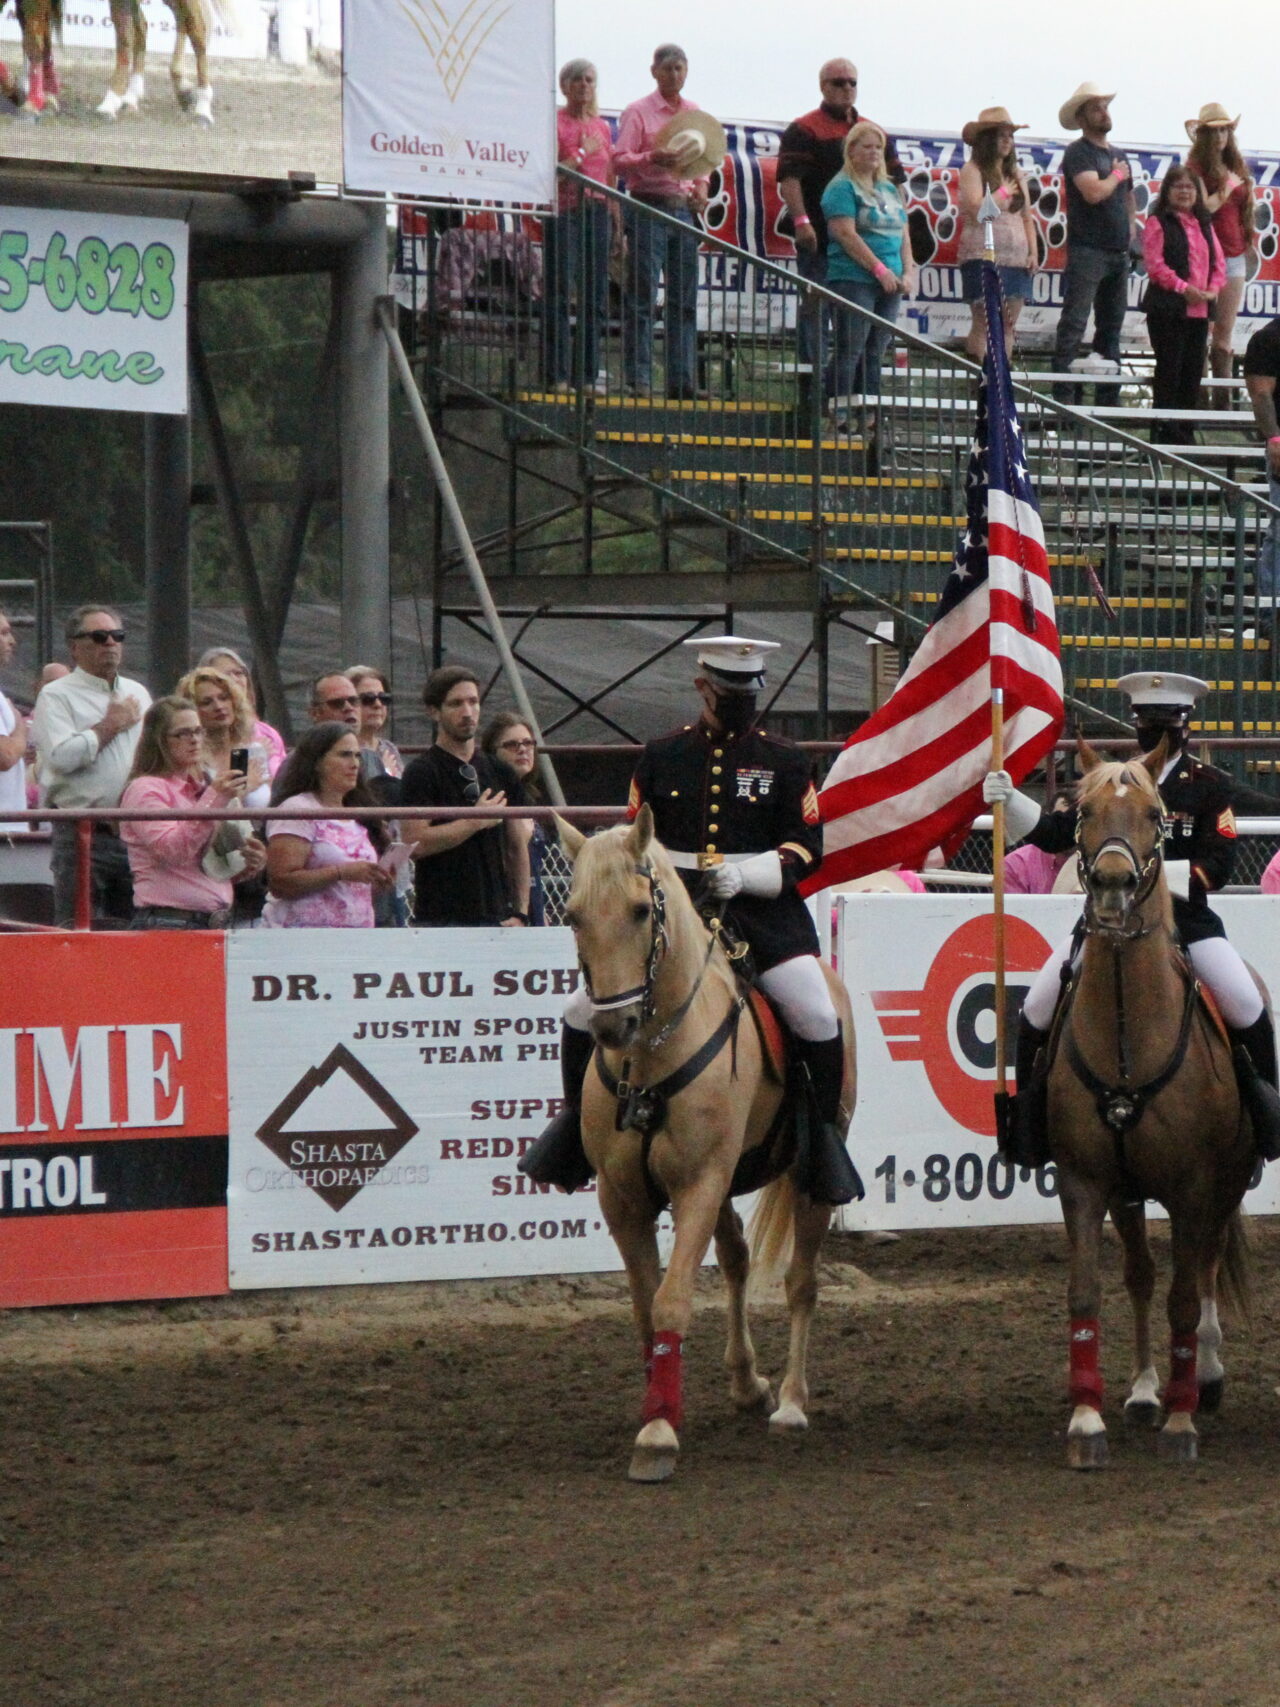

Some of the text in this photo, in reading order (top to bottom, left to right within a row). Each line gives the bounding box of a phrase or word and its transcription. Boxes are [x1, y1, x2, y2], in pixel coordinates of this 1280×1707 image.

[370, 132, 531, 168] Golden Valley
[420, 164, 483, 177] BANK
[252, 974, 331, 1002] DR.
[352, 971, 474, 999] PAUL
[353, 1017, 566, 1039] JUSTIN SPOR
[419, 1045, 503, 1064] TEAM
[290, 1140, 387, 1165] SHASTA
[251, 1218, 587, 1253] SHASTAORTHO.COM
